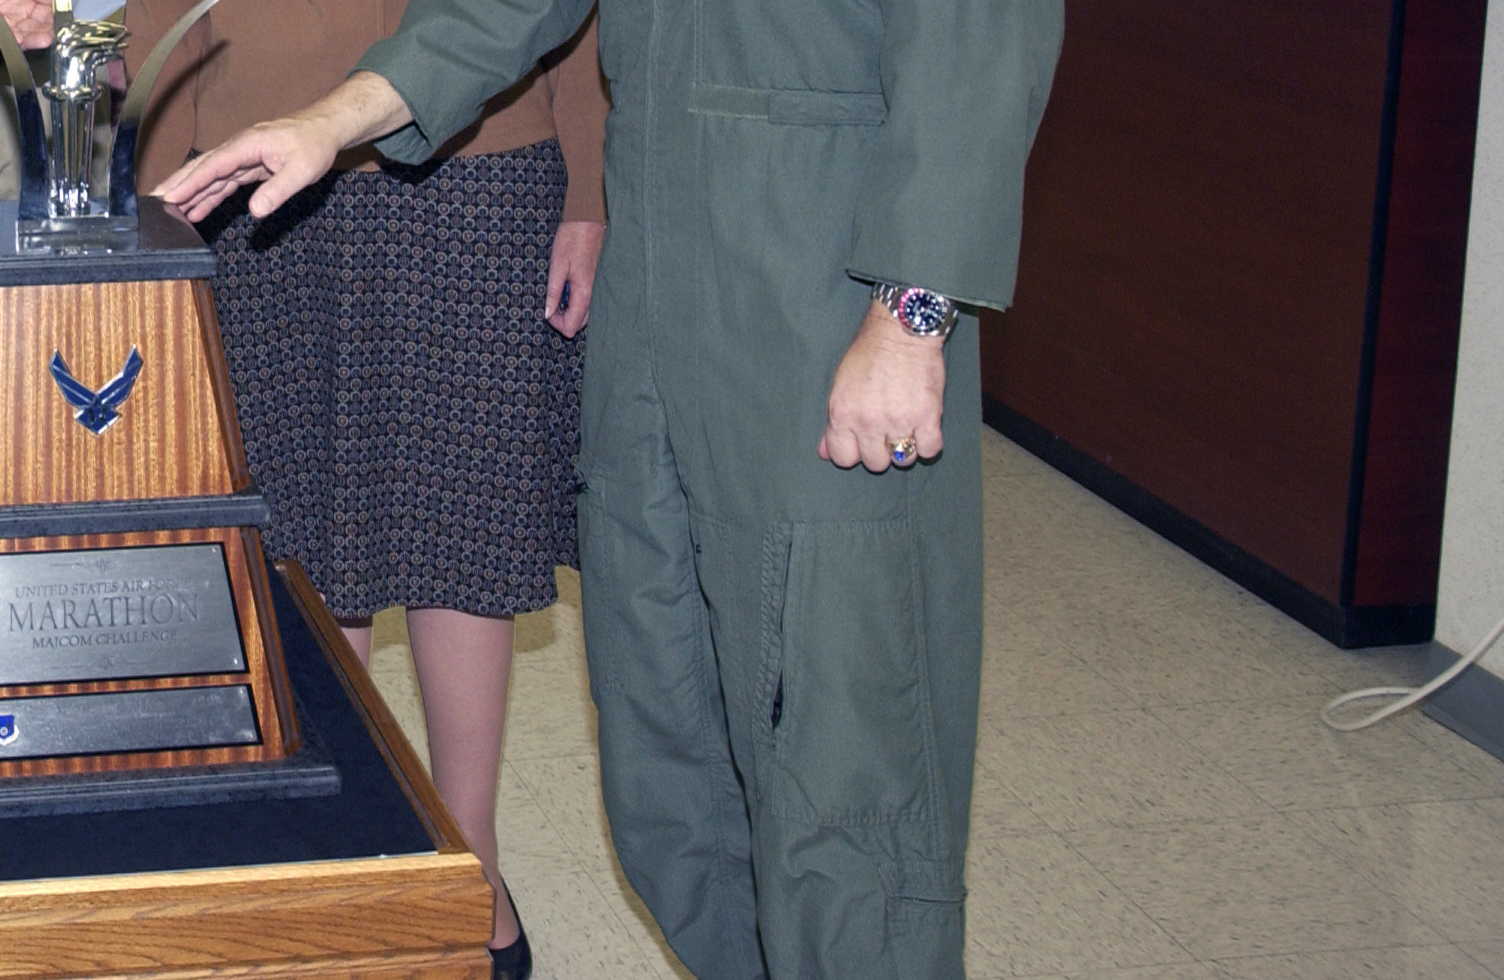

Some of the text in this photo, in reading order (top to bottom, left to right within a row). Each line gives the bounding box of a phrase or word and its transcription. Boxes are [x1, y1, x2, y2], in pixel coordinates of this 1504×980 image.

[15, 583, 69, 599] UNITED
[72, 581, 119, 596] STATES
[122, 580, 144, 593] AIR
[8, 593, 199, 632] MARATHON
[32, 629, 177, 650] MAJCOM CHALLENGE
